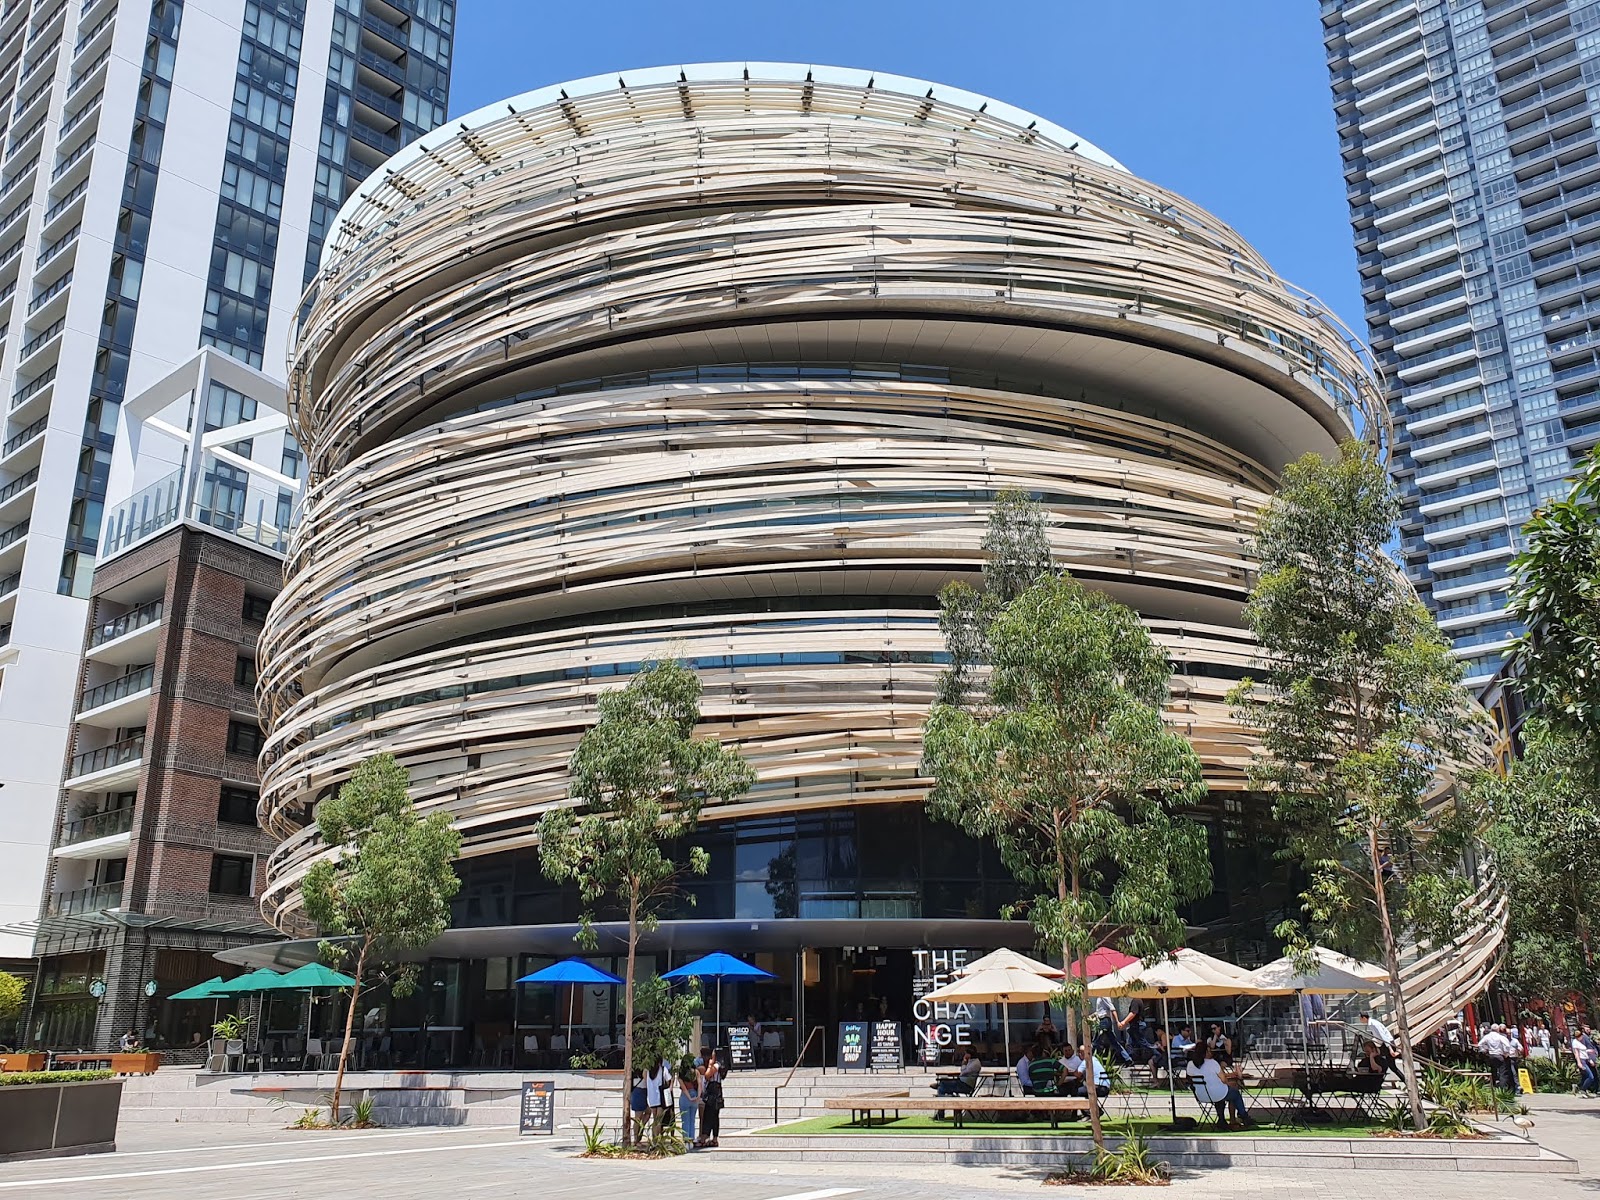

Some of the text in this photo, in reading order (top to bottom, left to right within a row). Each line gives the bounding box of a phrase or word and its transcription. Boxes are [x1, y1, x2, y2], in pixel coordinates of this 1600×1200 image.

[912, 949, 967, 970] THE
[913, 999, 972, 1020] CHA
[845, 1034, 860, 1043] BAR
[914, 1024, 971, 1045] NGE
[844, 1053, 859, 1062] SHOP
